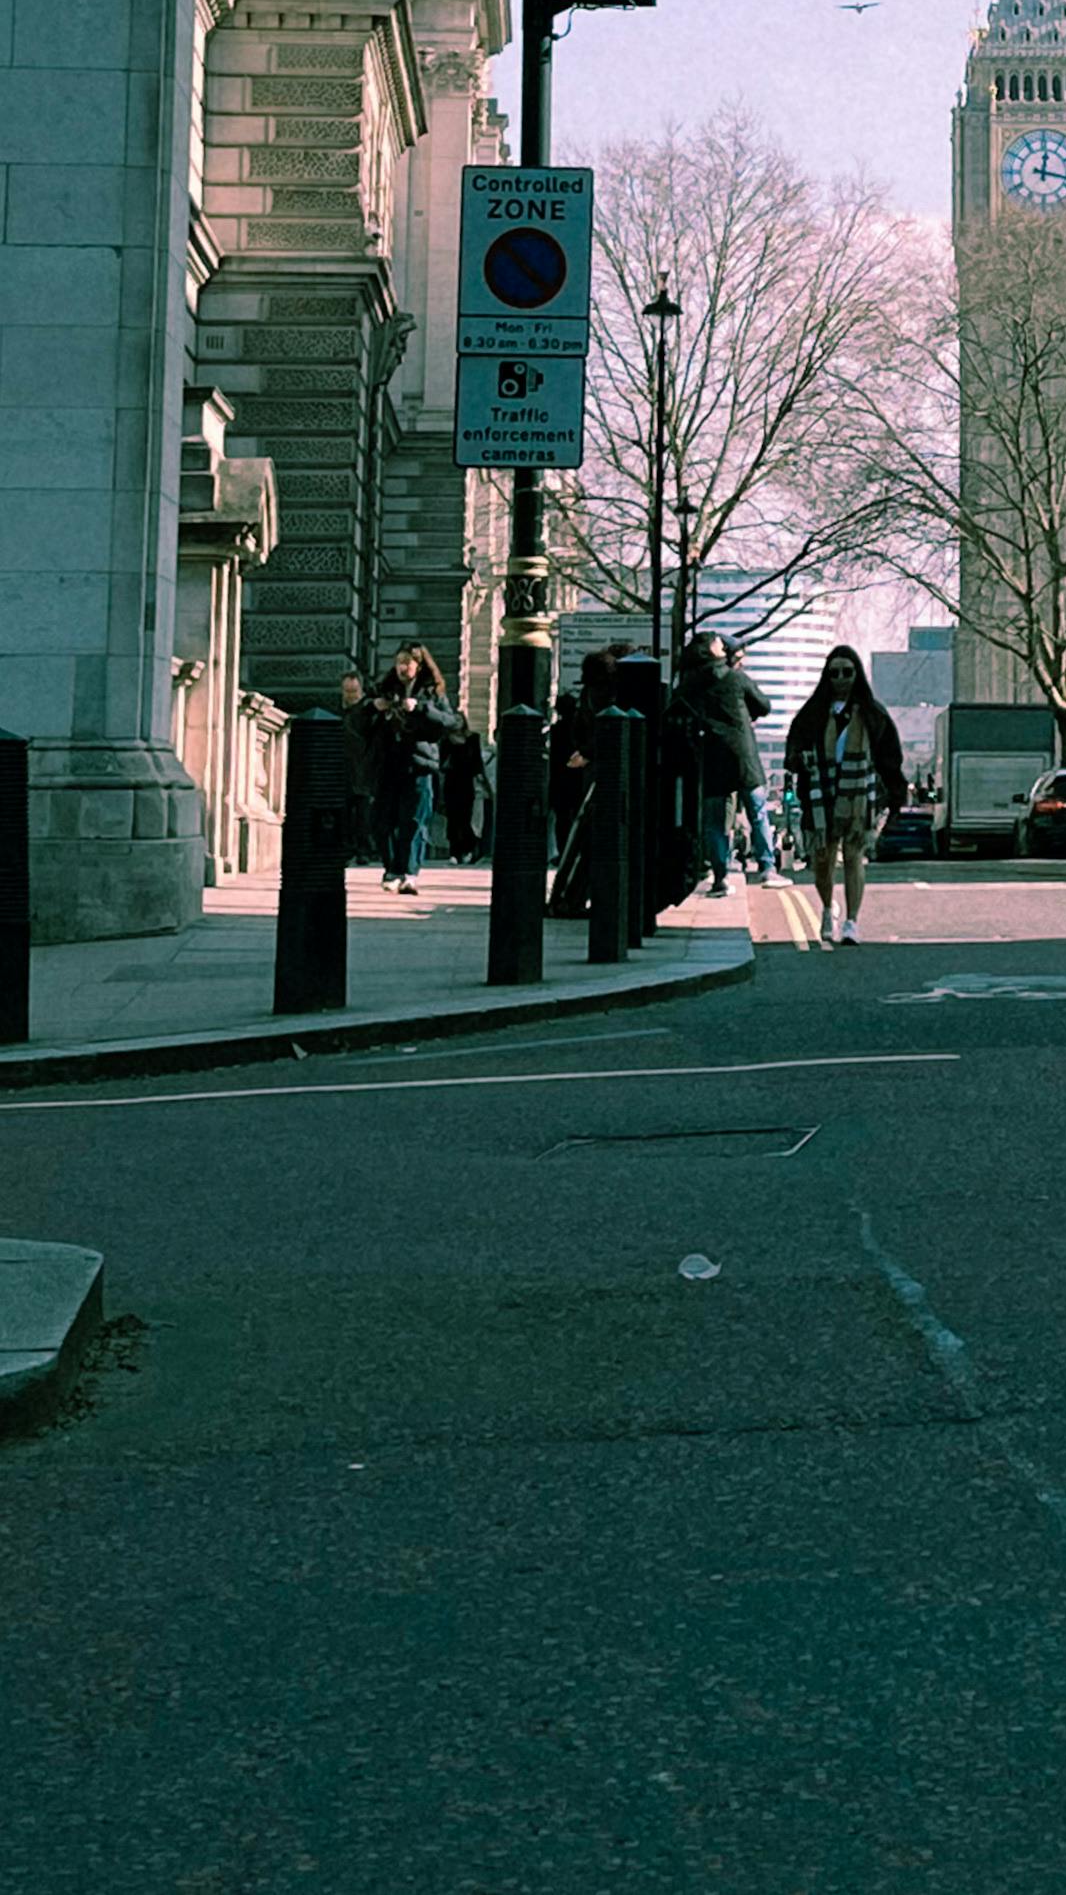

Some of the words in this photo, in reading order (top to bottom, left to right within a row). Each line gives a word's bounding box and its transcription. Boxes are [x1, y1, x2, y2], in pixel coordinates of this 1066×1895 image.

[472, 174, 583, 194] Controlled
[487, 198, 566, 220] ZONE
[495, 321, 524, 333] Mon
[498, 339, 518, 348] am
[562, 339, 583, 351] pm
[491, 407, 549, 423] Traffic
[462, 427, 575, 442] enforcement
[481, 449, 555, 462] cameras
